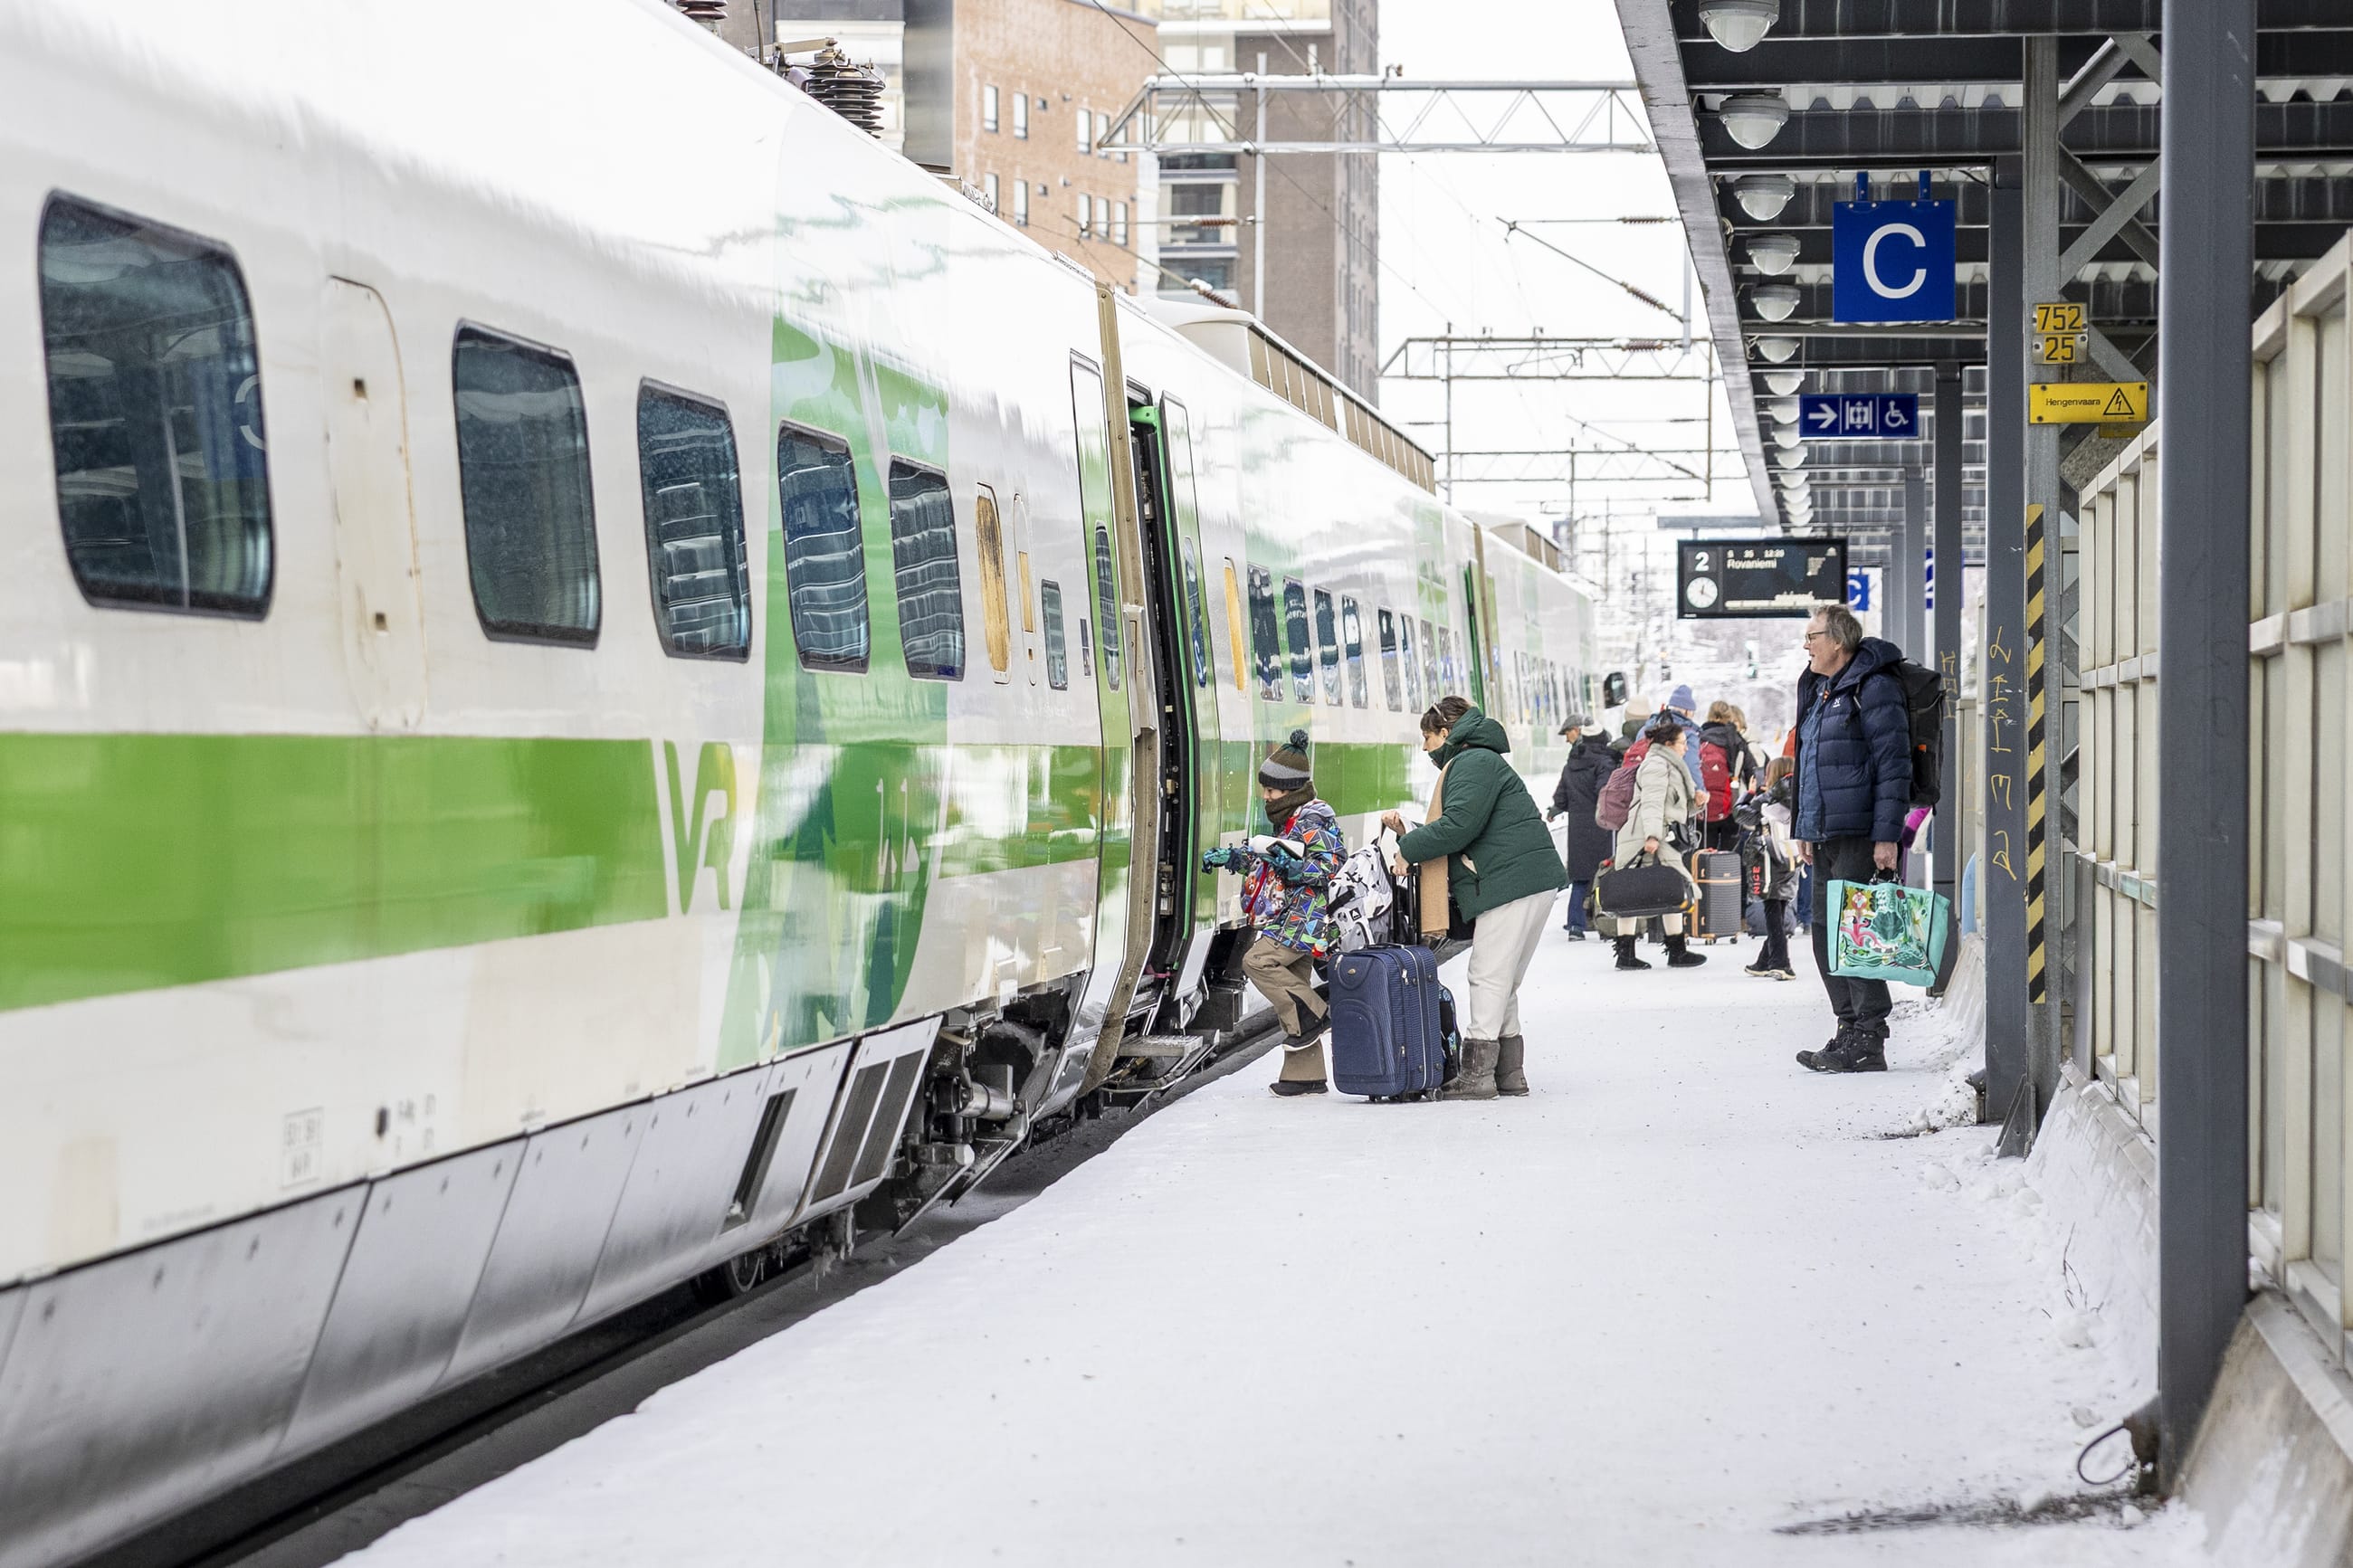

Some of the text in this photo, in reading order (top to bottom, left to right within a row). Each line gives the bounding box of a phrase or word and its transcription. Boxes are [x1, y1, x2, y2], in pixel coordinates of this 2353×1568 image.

[1862, 223, 1927, 299] C
[2038, 306, 2082, 330] 752
[2045, 337, 2074, 361] 25
[2045, 398, 2101, 407] Hengenvaara
[1695, 552, 1710, 571] 2
[1727, 558, 1777, 569] Rovaniemi
[663, 739, 737, 916] VR
